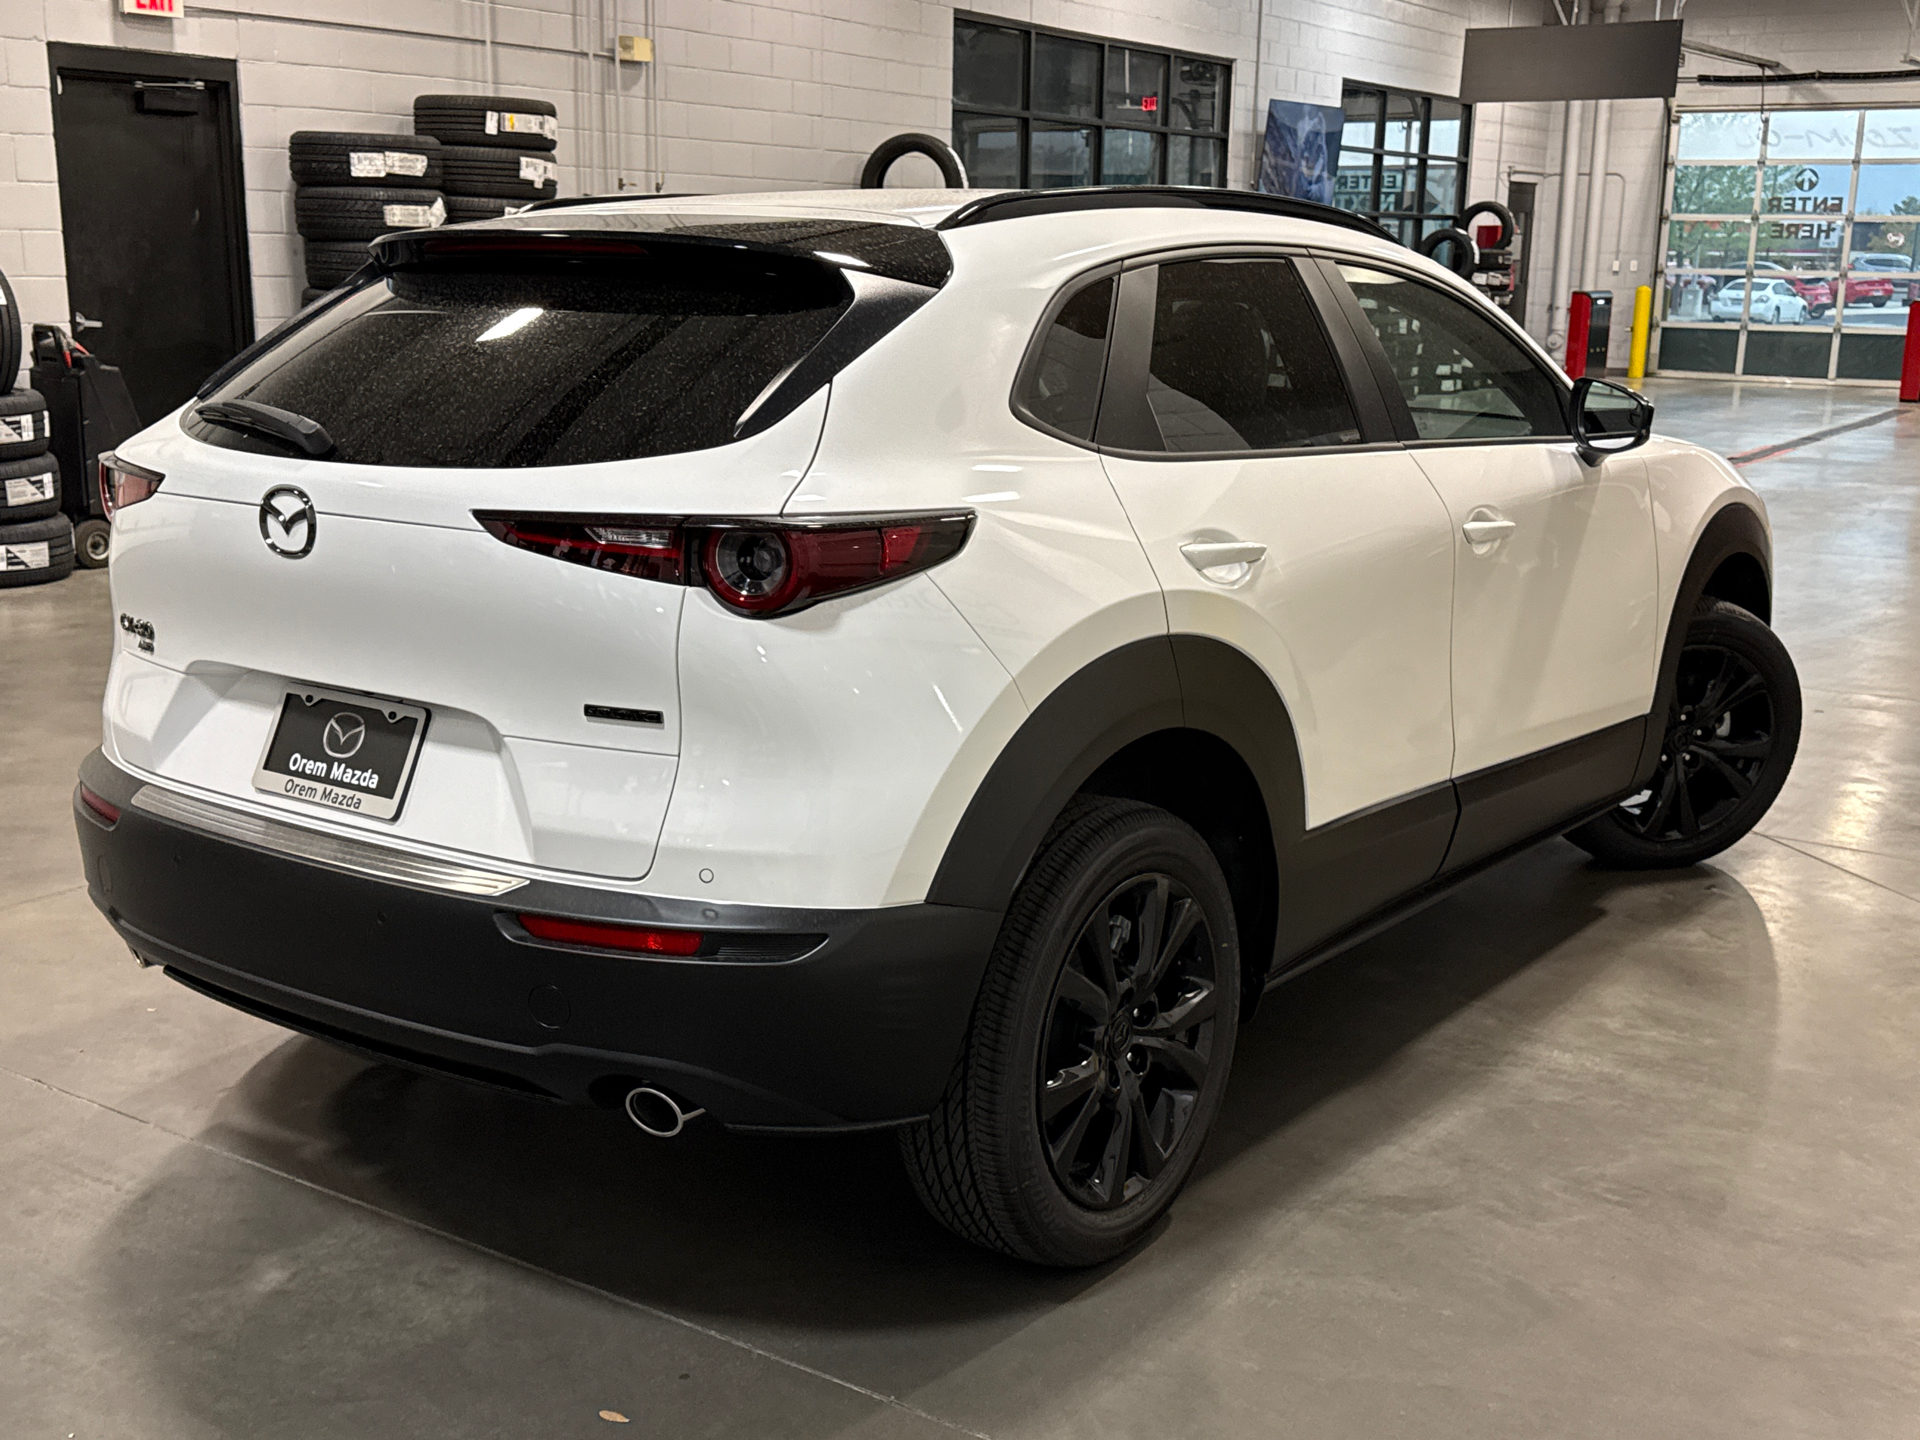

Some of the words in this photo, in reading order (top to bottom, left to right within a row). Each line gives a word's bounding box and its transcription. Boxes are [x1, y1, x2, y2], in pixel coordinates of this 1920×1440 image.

[288, 752, 328, 778] Orem
[329, 761, 379, 789] Mazda
[284, 778, 318, 800] Orem
[320, 786, 362, 810] Mazda
